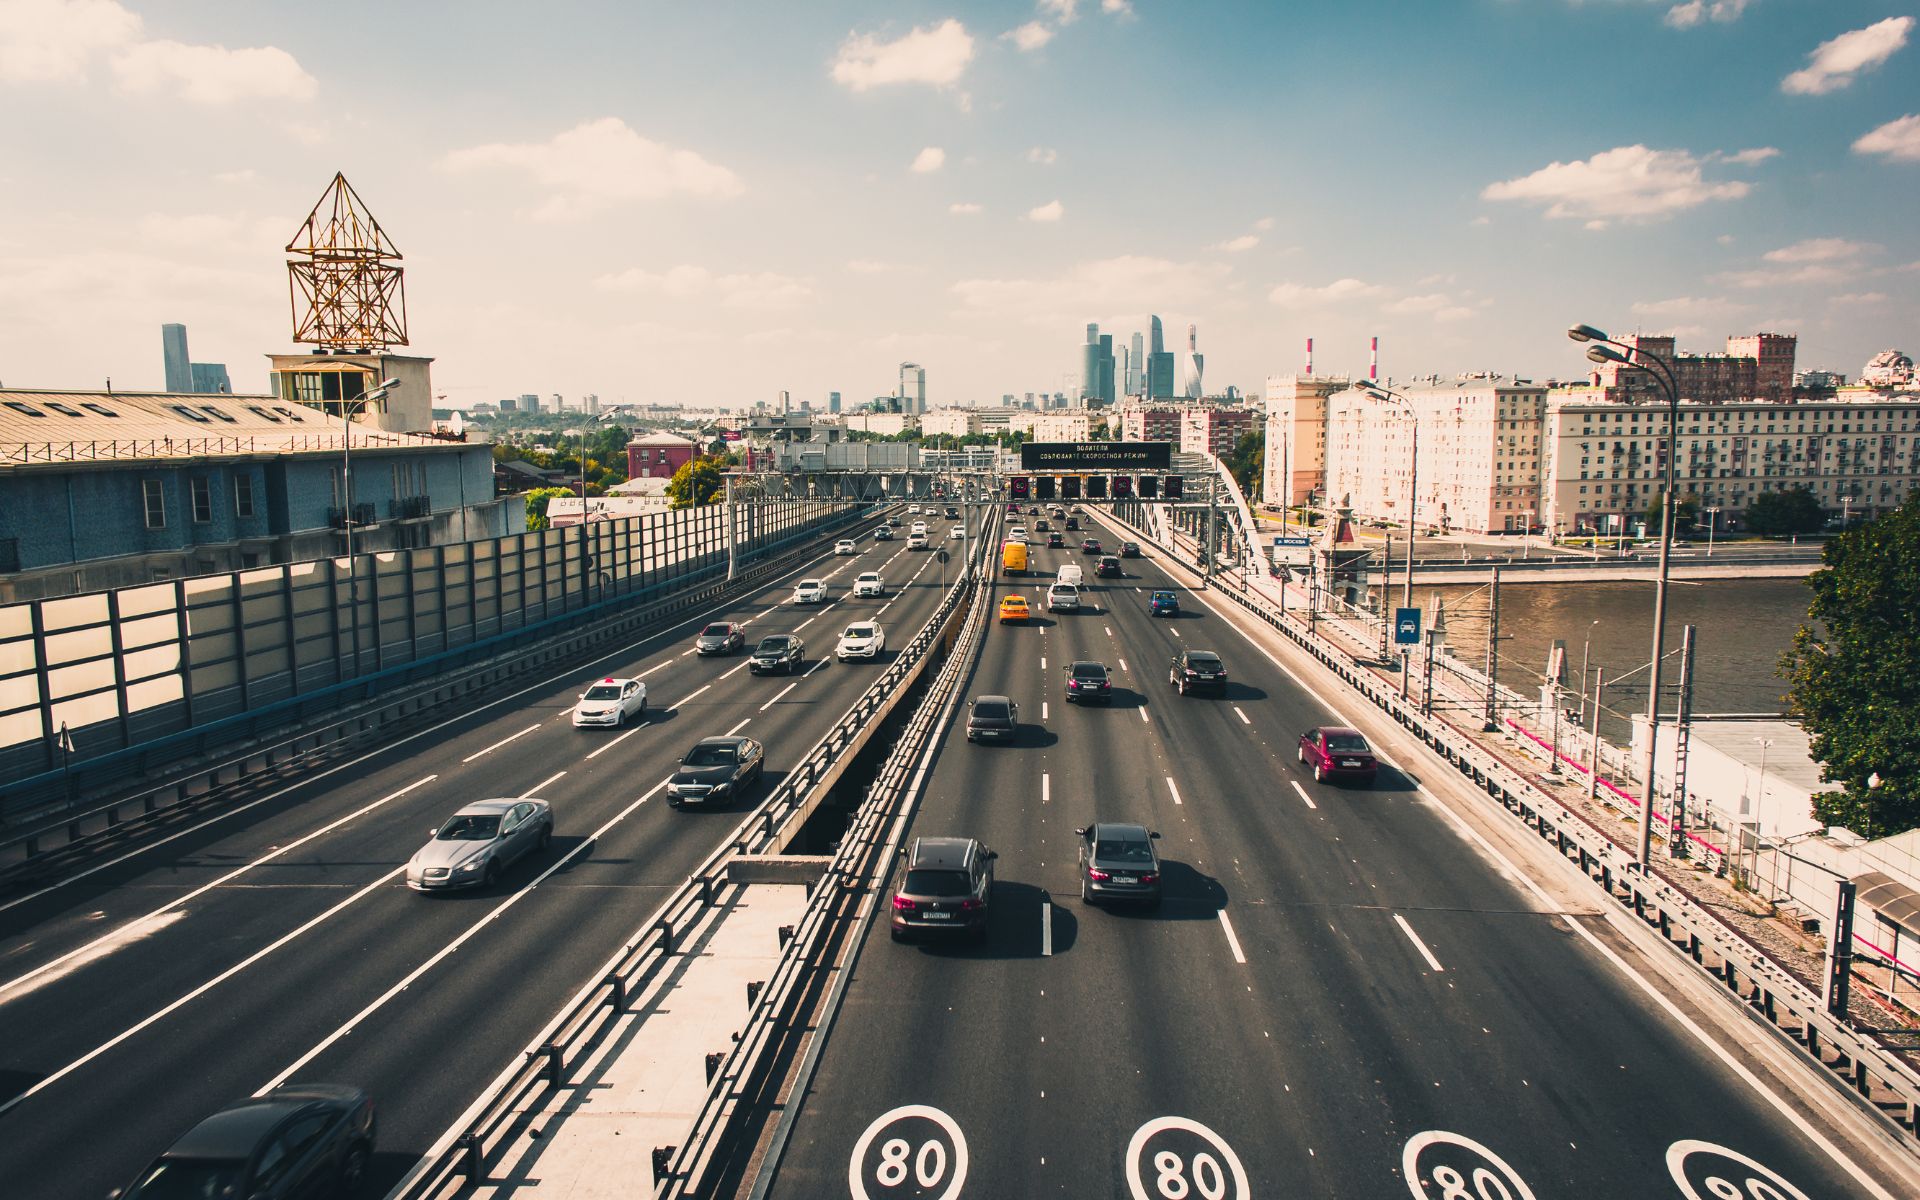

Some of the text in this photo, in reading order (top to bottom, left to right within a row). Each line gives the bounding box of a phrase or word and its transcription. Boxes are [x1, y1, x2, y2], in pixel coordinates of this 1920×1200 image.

[877, 1139, 946, 1187] 80
[1154, 1151, 1225, 1200] 80
[1433, 1166, 1512, 1200] 80
